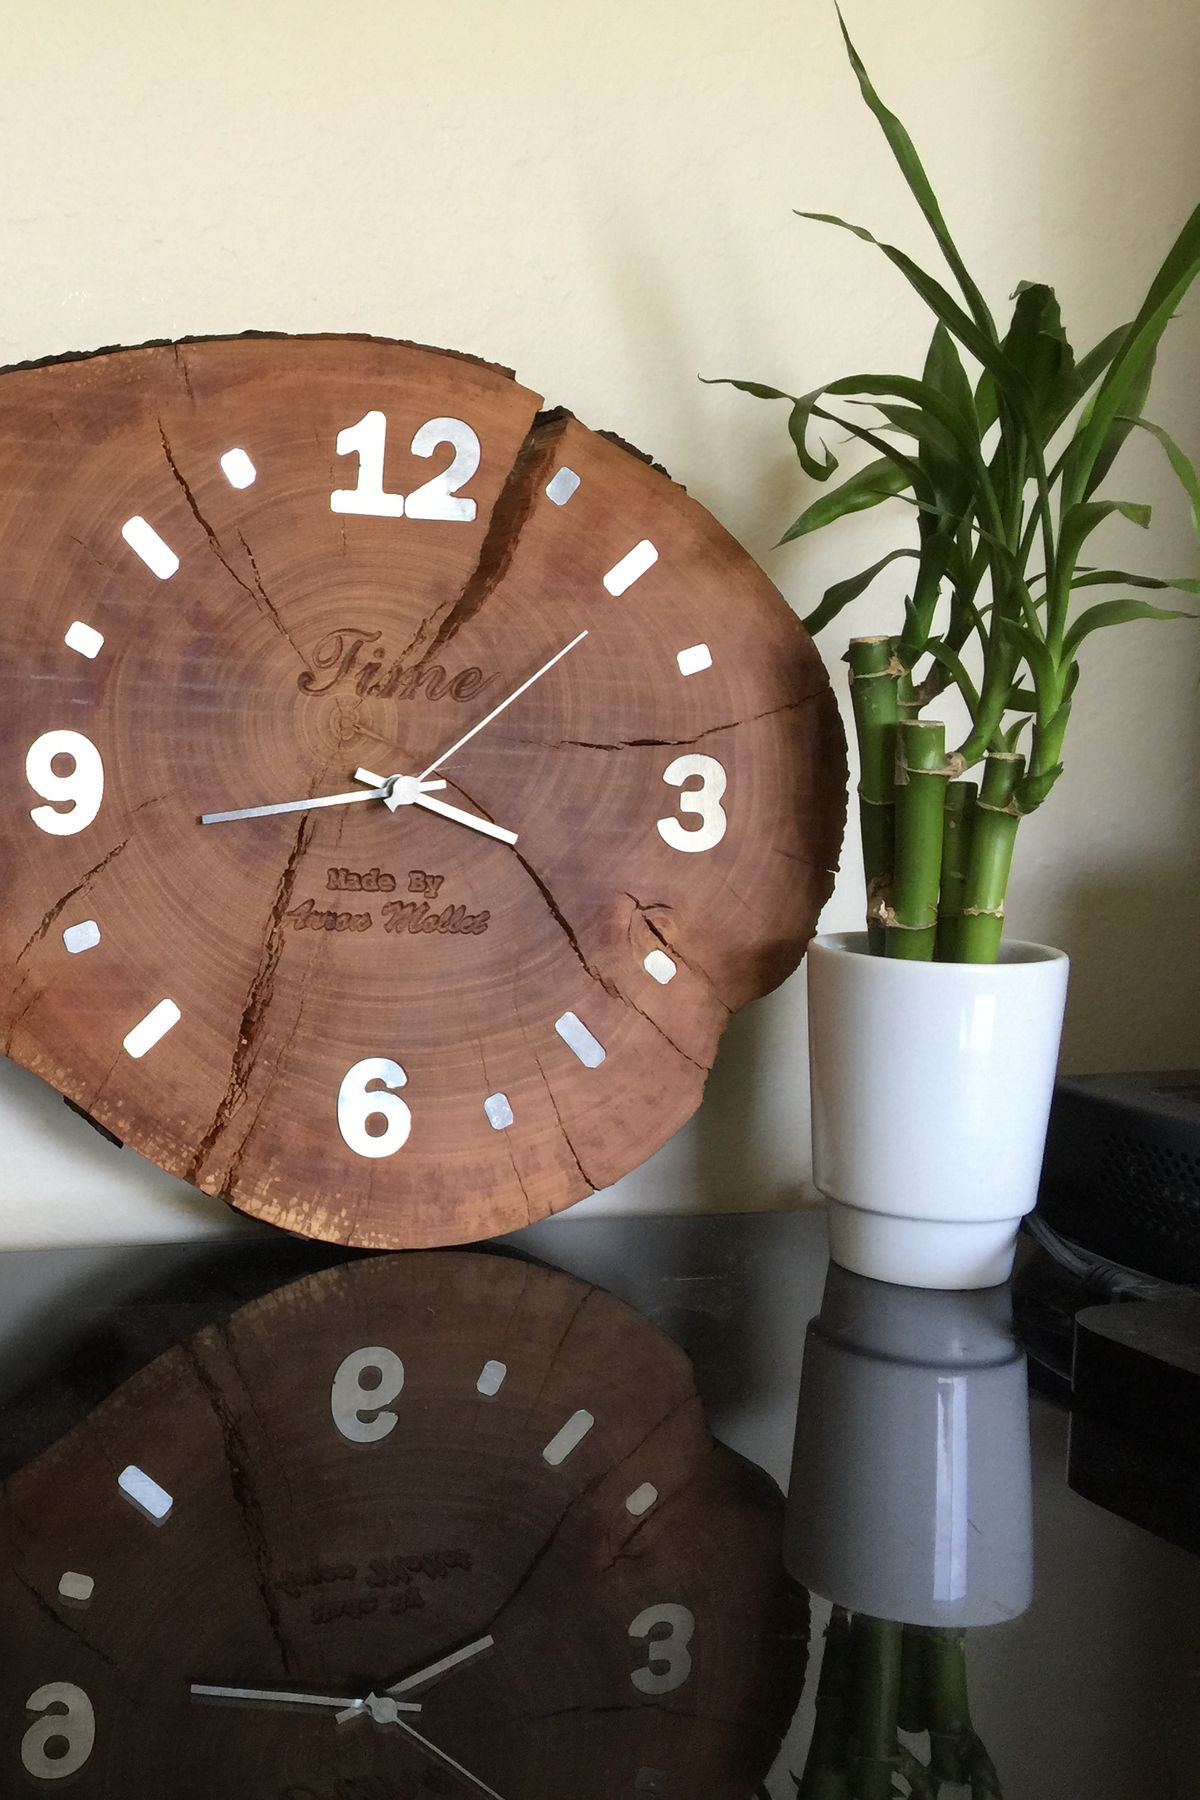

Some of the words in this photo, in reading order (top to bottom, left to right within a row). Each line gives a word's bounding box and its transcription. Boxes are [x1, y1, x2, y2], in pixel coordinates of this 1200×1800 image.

[331, 411, 481, 522] 12
[297, 628, 500, 703] Time
[25, 730, 104, 836] 9
[657, 754, 727, 853] 3
[326, 867, 396, 892] Made
[408, 870, 445, 899] By
[337, 1058, 412, 1159] 6
